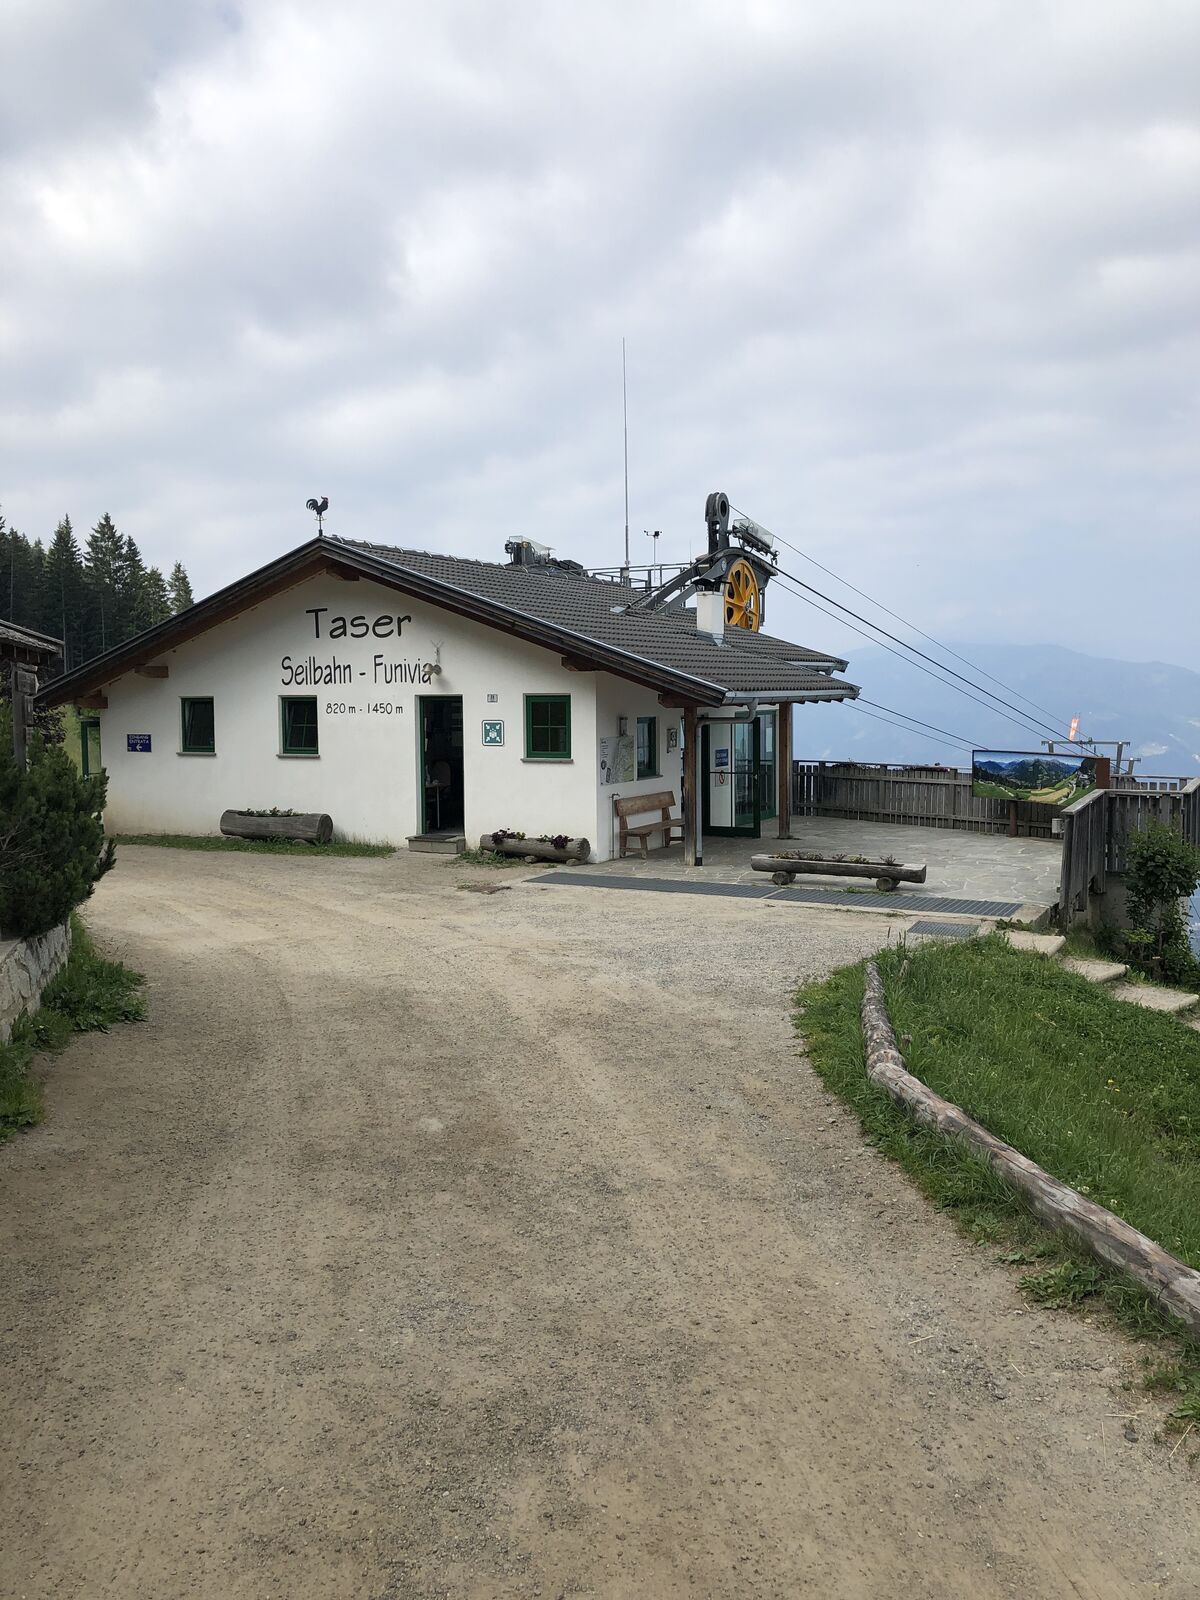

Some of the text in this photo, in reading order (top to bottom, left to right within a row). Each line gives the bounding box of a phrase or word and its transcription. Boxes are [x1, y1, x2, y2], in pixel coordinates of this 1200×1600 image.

[305, 607, 412, 640] Taser
[281, 655, 352, 686] Seilbahn
[373, 654, 432, 685] Funivia
[325, 702, 346, 715] 820
[348, 705, 356, 714] m
[367, 702, 393, 715] 1450
[395, 705, 403, 714] m
